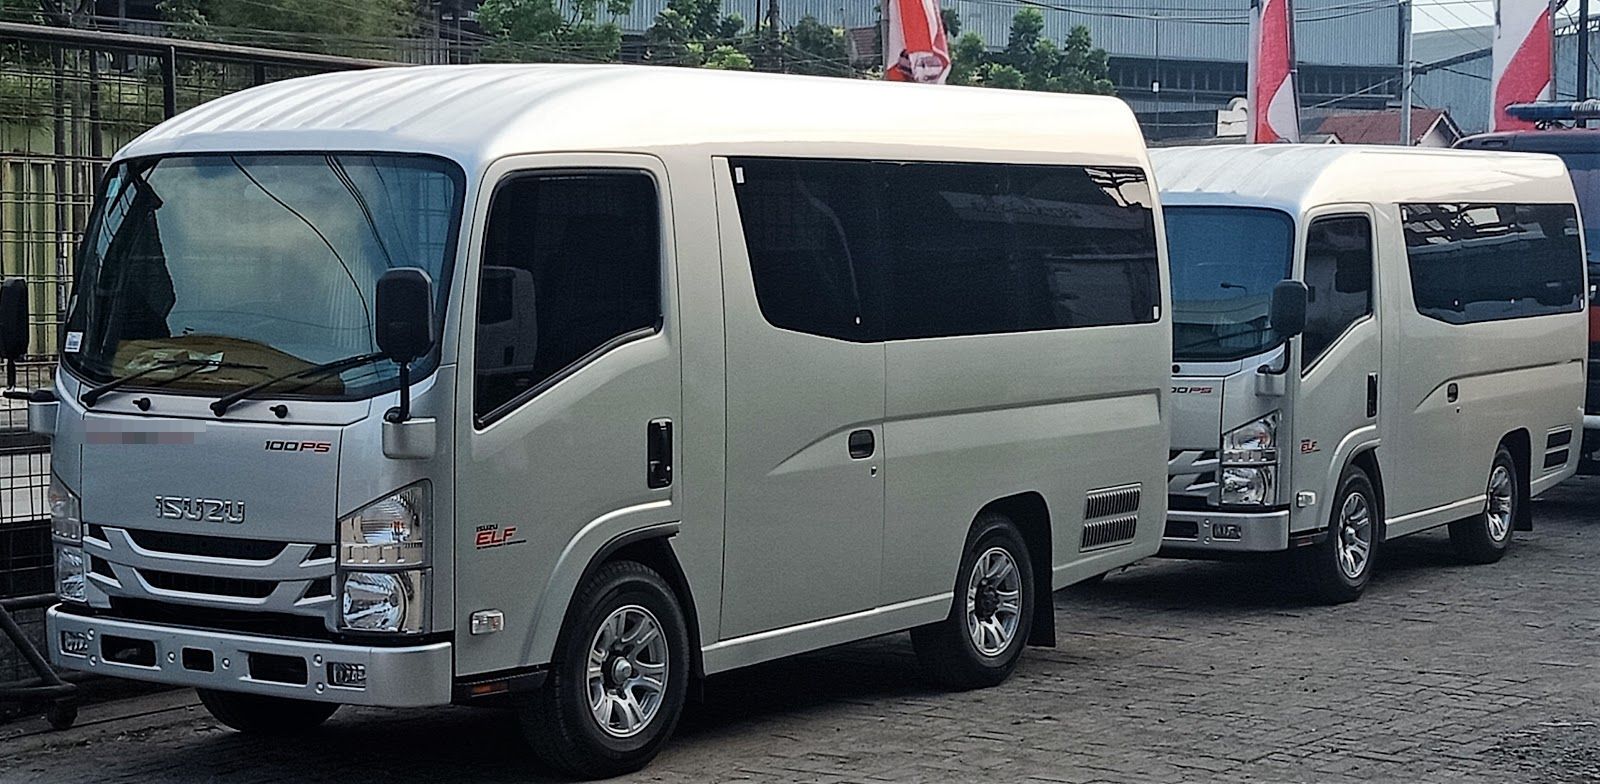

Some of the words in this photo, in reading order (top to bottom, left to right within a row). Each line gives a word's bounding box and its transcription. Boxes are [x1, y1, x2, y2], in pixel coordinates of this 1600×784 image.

[265, 441, 332, 453] 100PS
[155, 496, 245, 523] ISUZU
[476, 528, 516, 545] ELF
